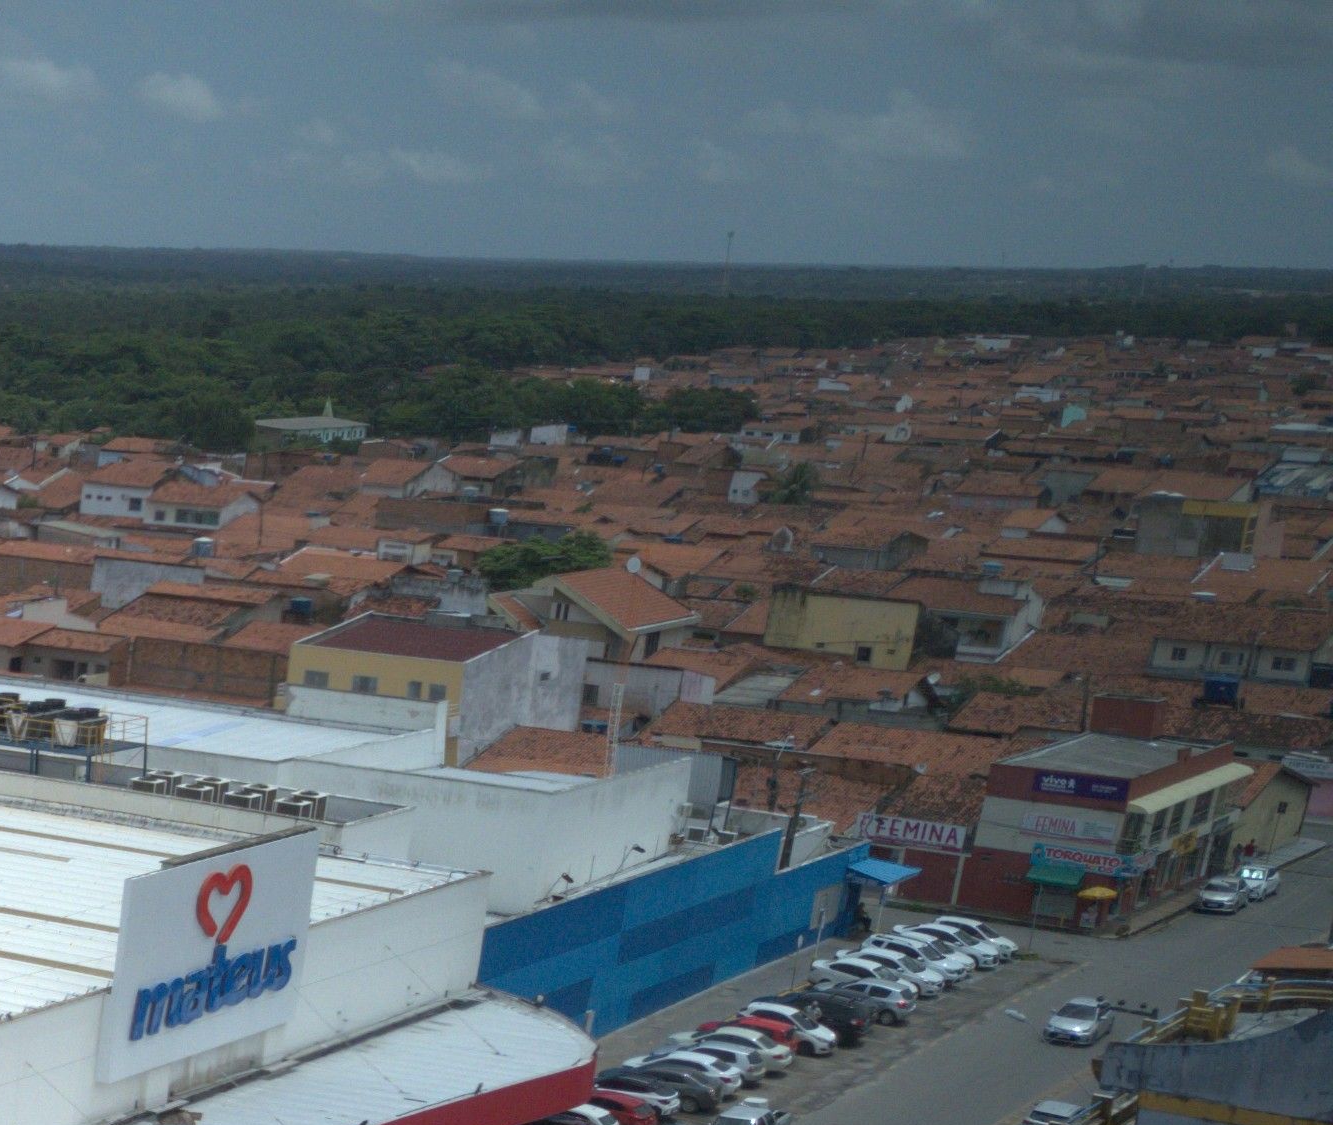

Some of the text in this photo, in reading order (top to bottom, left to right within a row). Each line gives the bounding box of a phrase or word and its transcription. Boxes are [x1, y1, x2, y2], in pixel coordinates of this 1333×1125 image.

[1042, 775, 1067, 786] vivo
[875, 816, 959, 845] FEMINA
[1035, 816, 1076, 833] FEMINA
[1045, 848, 1121, 867] TORQUATO
[129, 936, 297, 1041] mateus
